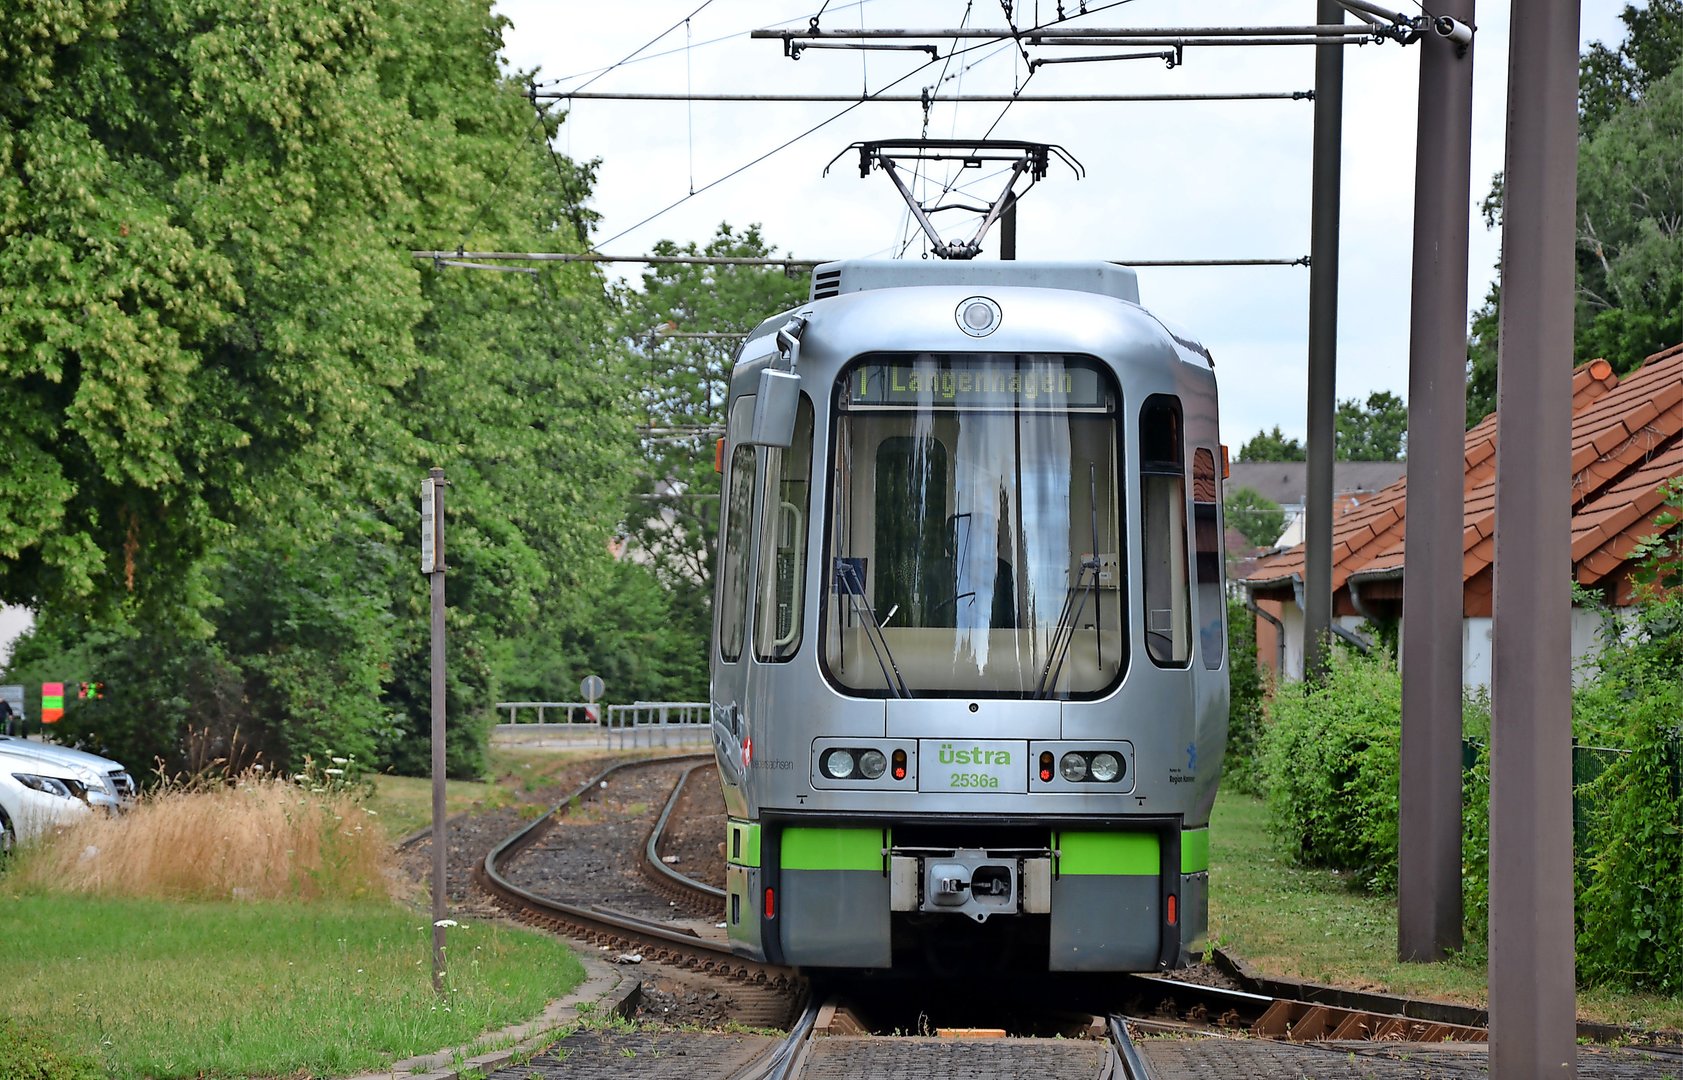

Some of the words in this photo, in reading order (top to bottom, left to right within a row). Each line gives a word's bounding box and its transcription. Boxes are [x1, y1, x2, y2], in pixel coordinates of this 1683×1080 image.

[892, 364, 1072, 399] Langenhagen
[939, 744, 1011, 765] üstra
[950, 773, 998, 788] 2536a
